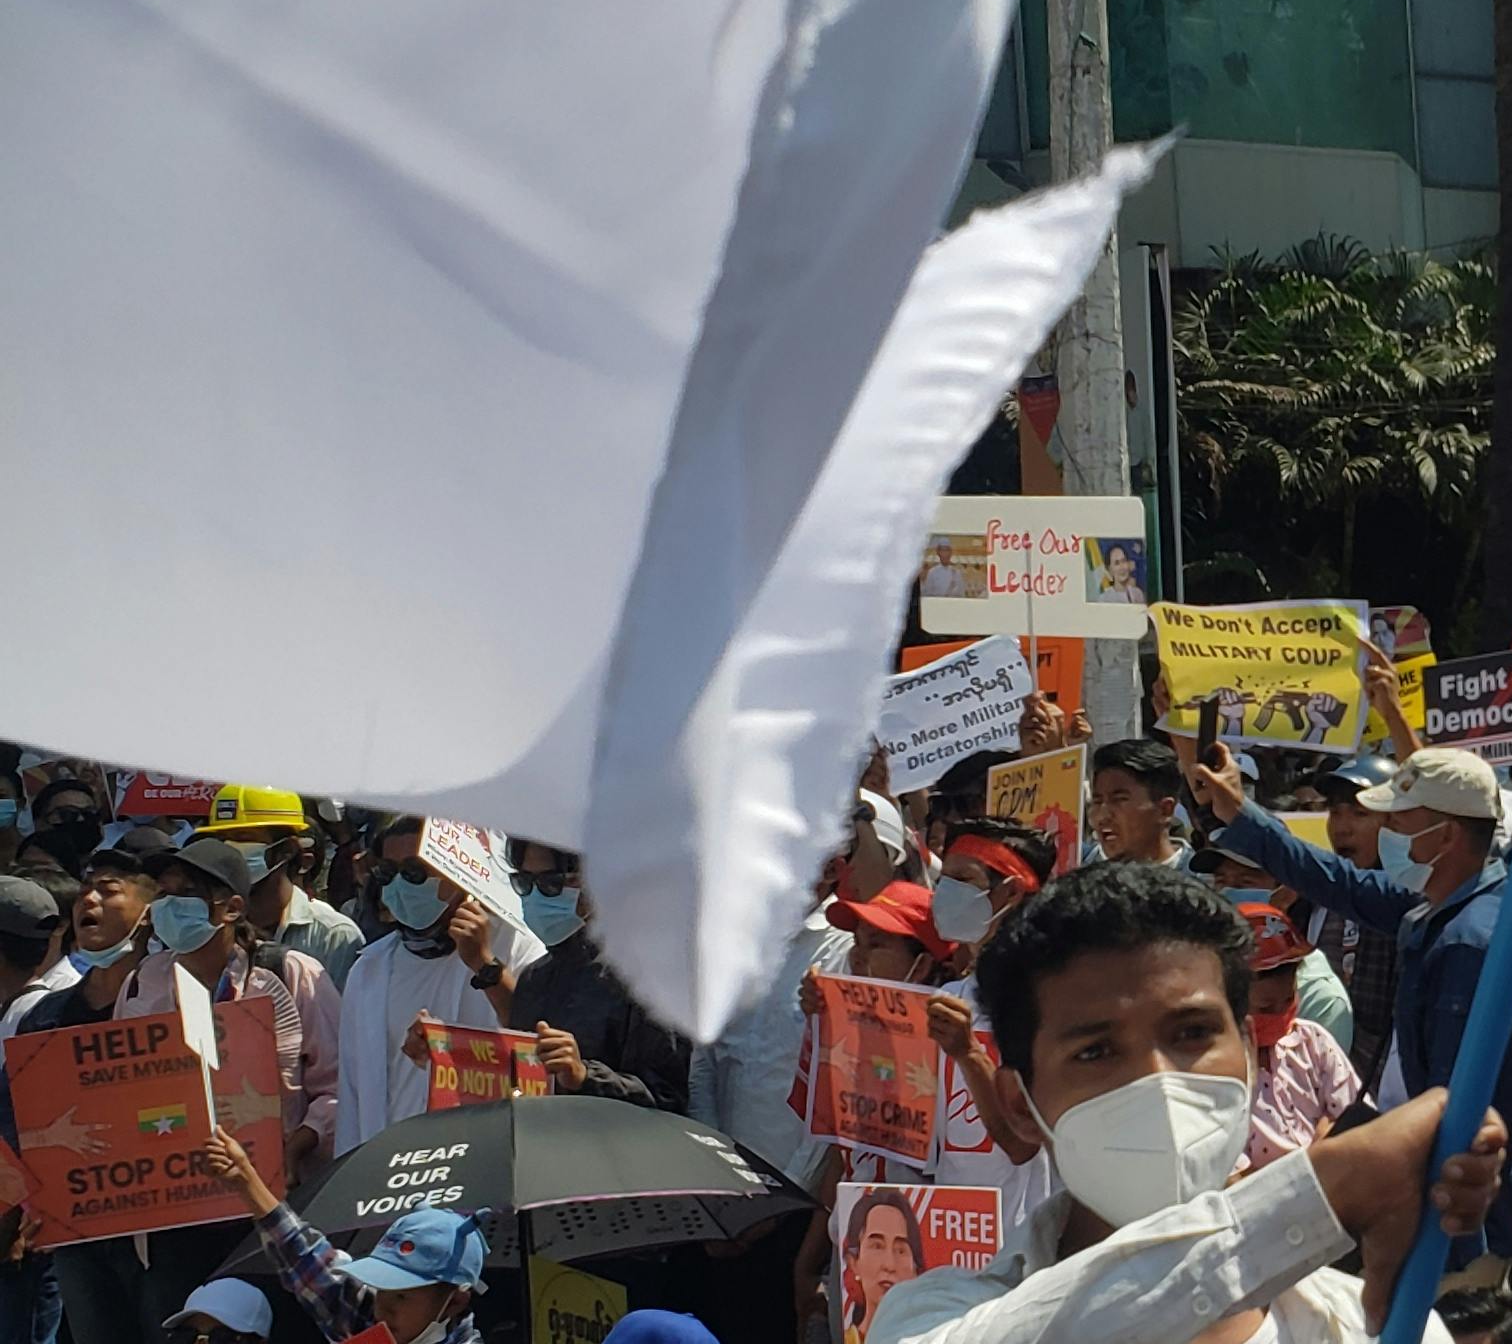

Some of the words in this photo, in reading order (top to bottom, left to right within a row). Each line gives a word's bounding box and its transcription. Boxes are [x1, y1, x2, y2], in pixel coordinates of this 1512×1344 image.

[986, 519, 1033, 555] Free
[1040, 528, 1083, 555] Our
[990, 564, 1067, 596] Leader
[1162, 607, 1194, 627] We
[1200, 614, 1255, 635] Don't
[1261, 614, 1342, 637] Accept
[1170, 641, 1272, 662] MILITARY
[1281, 647, 1342, 666] COUP
[1440, 667, 1508, 701] Fight
[911, 722, 958, 748] More
[962, 697, 1026, 728] Militar
[907, 721, 1020, 770] Dictatorship
[993, 767, 1026, 791] JOIN
[1029, 763, 1044, 779] IN
[429, 826, 490, 882] LEADER
[836, 982, 880, 1009] HELP
[885, 990, 908, 1017] US
[72, 1022, 168, 1065] HELP
[470, 1039, 500, 1065] WE
[79, 1064, 129, 1087] SAVE
[435, 1065, 459, 1091] DO
[463, 1069, 496, 1097] NOT
[839, 1090, 878, 1120] STOP
[880, 1100, 928, 1135] CRIME
[388, 1143, 470, 1168] HEAR
[67, 1158, 155, 1195] STOP
[387, 1166, 451, 1189] OUR
[71, 1190, 160, 1218] AGAINST
[356, 1185, 465, 1217] VOICES
[930, 1208, 995, 1245] FREE
